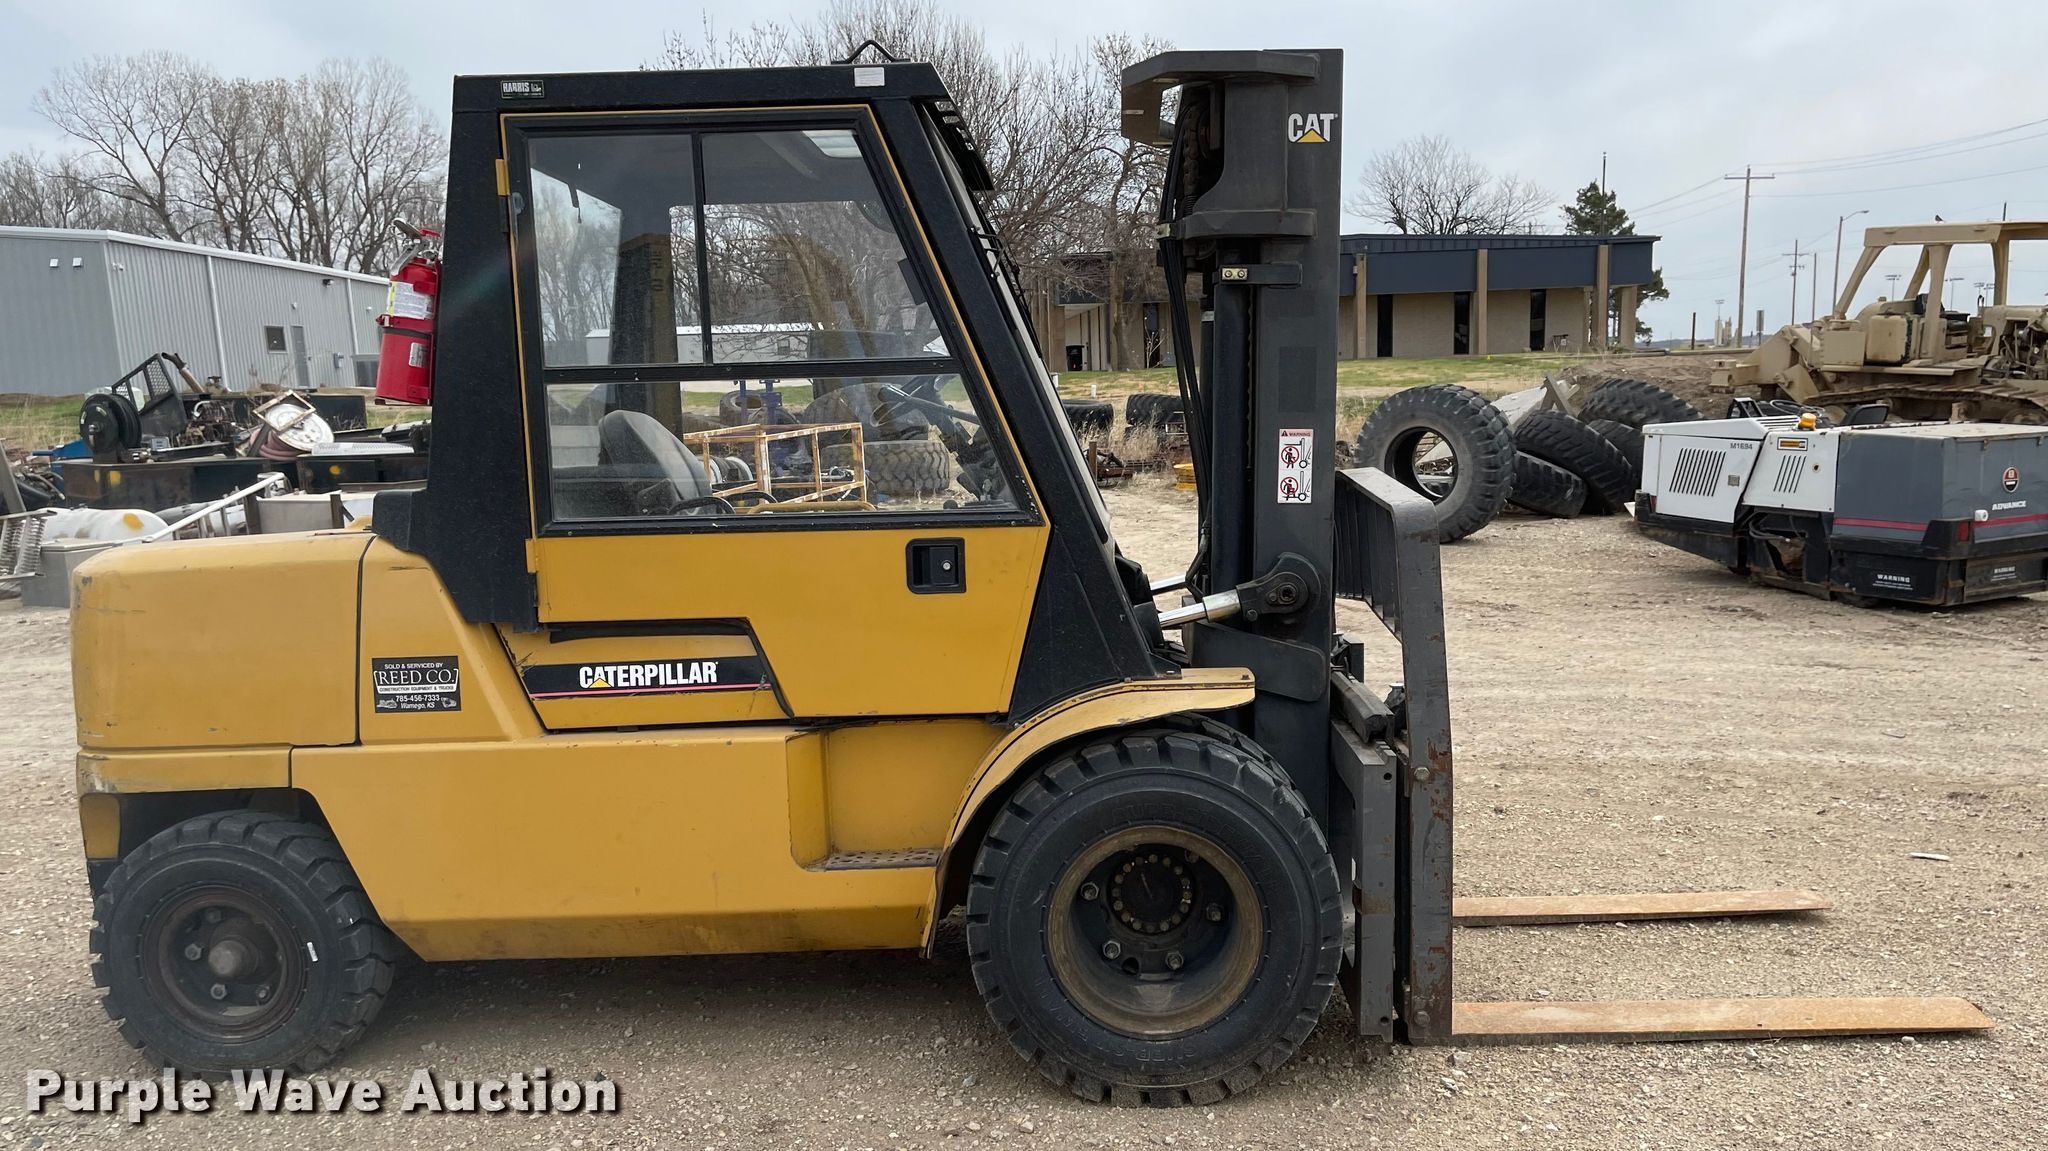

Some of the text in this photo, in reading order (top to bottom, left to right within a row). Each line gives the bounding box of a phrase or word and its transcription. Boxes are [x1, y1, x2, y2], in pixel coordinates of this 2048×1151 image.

[503, 82, 529, 92] HARRIS
[1288, 113, 1335, 142] CAT
[1877, 574, 1910, 583] WARNING
[379, 669, 454, 684] REED CO.
[579, 661, 718, 689] CATERPILLAR
